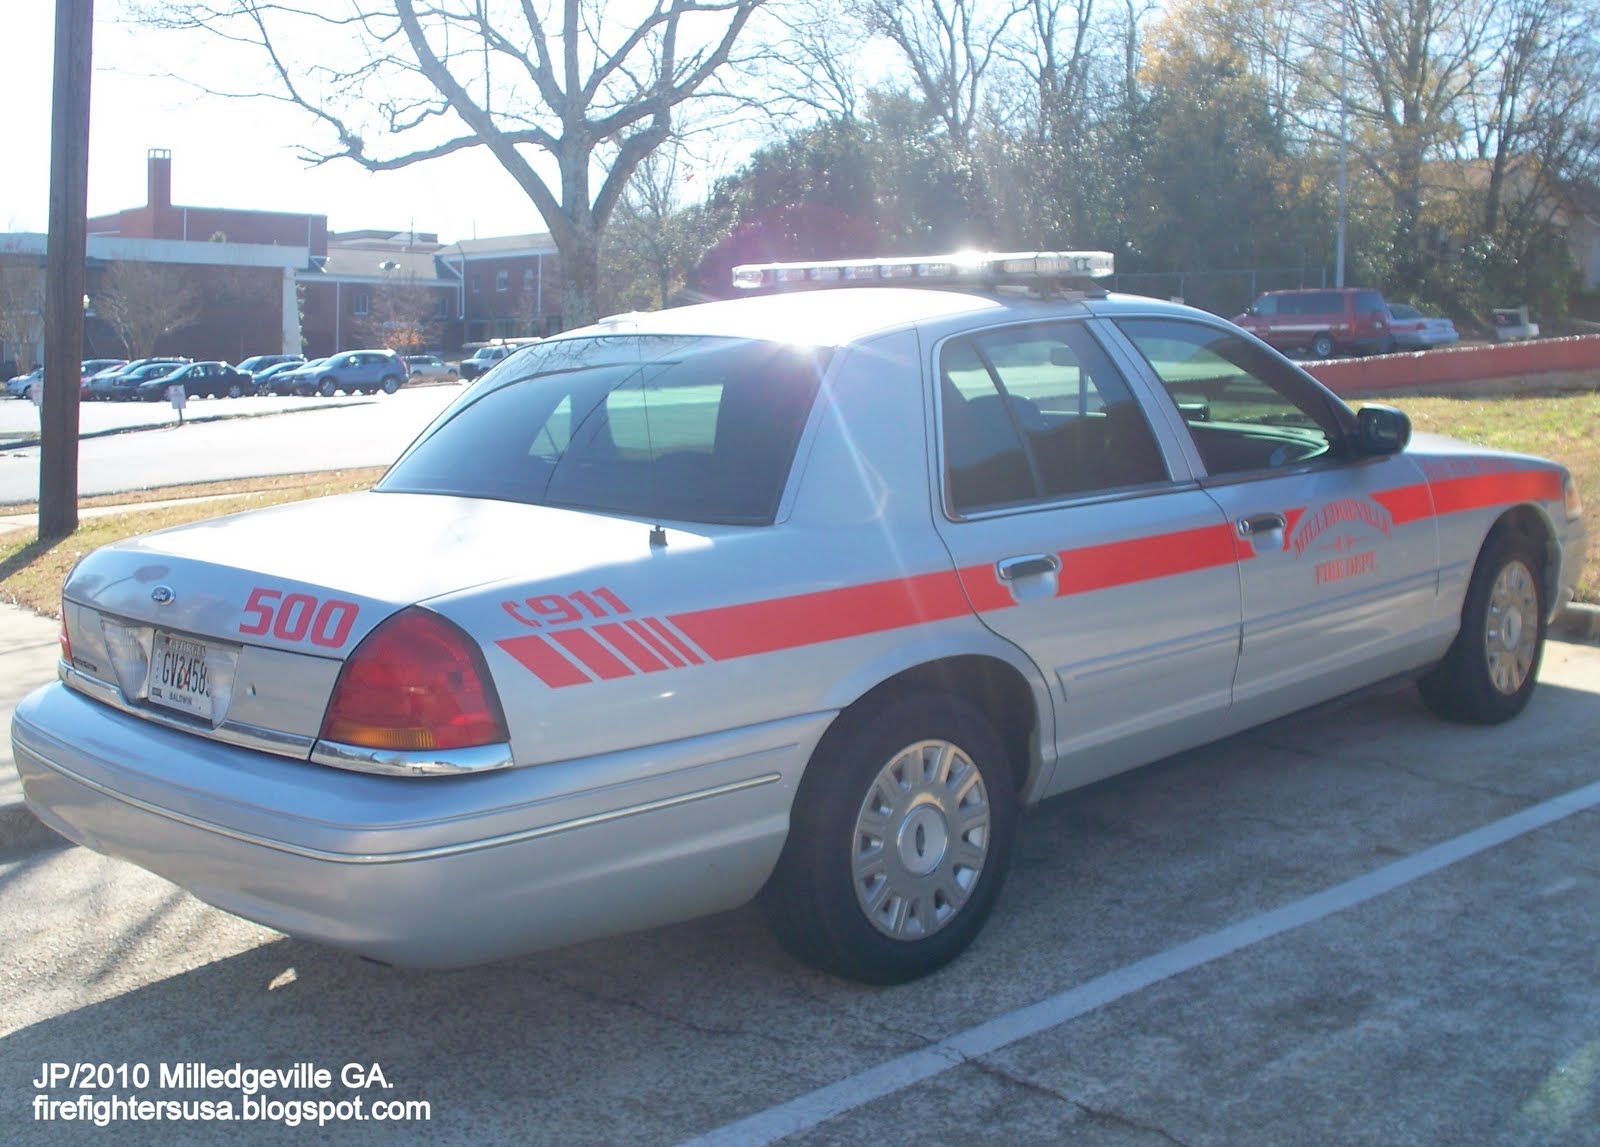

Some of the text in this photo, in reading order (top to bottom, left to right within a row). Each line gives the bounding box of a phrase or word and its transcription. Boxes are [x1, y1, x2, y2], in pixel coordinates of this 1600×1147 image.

[1294, 498, 1392, 560] MILLEDGEVILLE
[1314, 551, 1376, 585] FIRE DEPT
[239, 586, 360, 648] 500
[525, 587, 632, 625] 911
